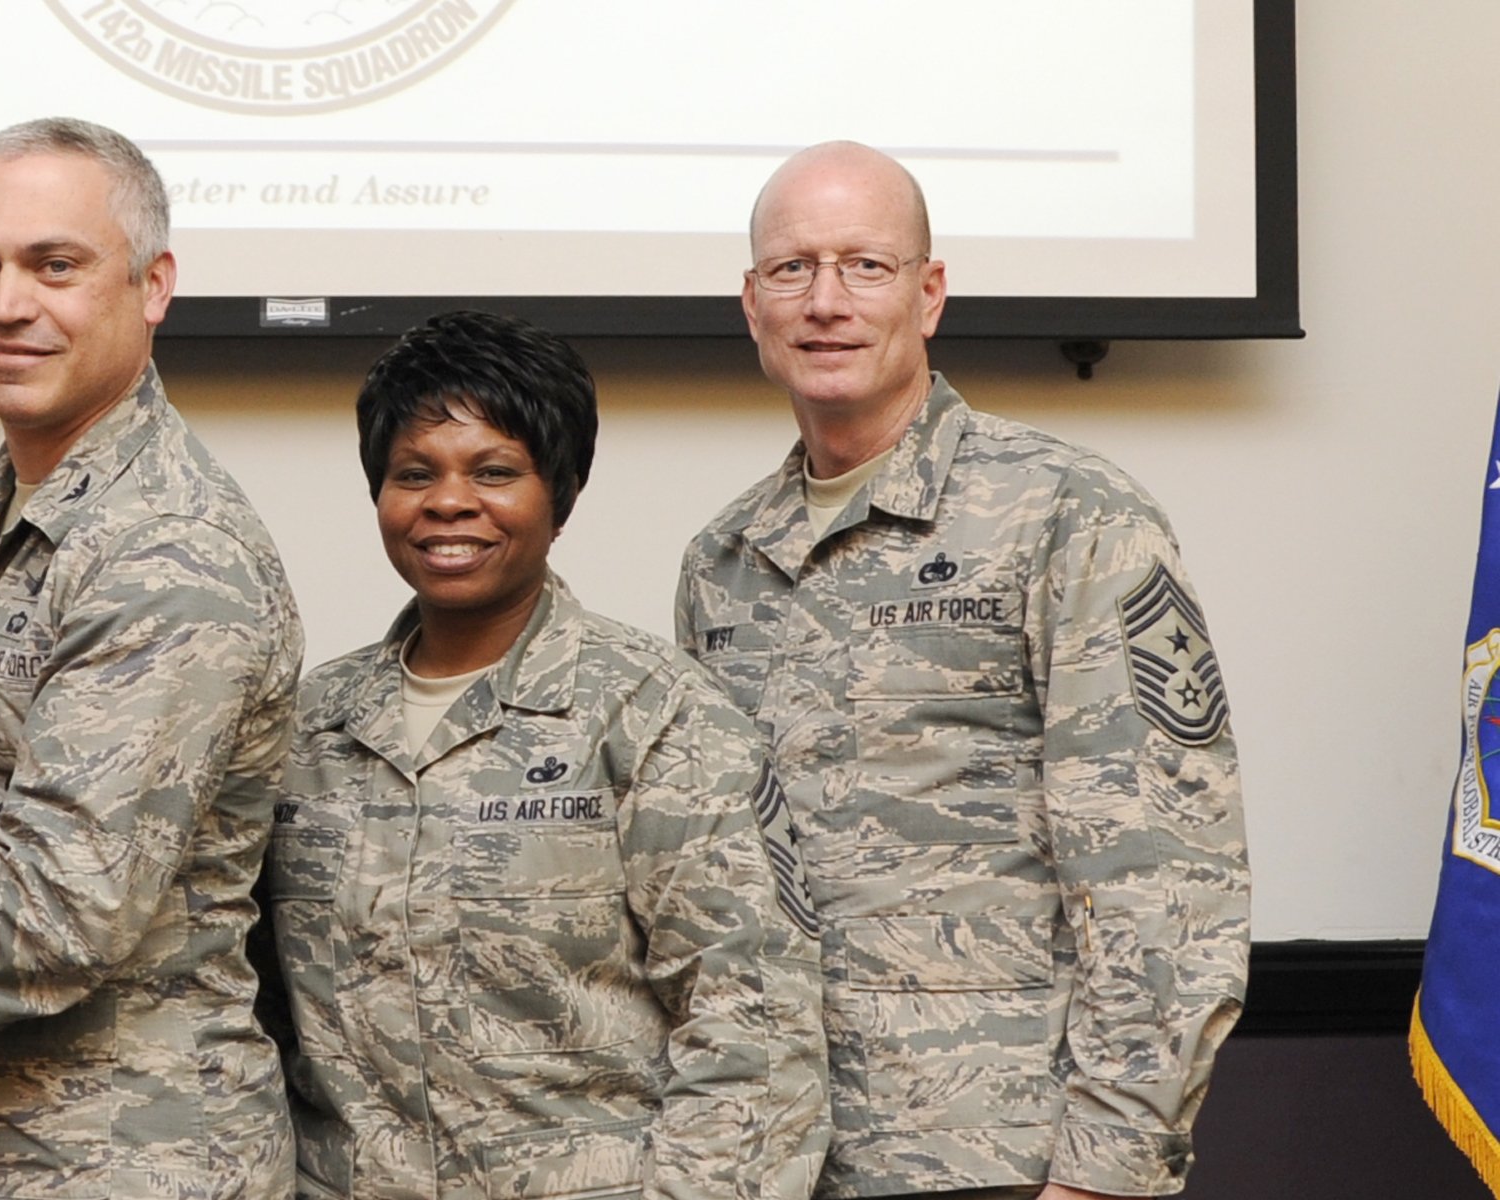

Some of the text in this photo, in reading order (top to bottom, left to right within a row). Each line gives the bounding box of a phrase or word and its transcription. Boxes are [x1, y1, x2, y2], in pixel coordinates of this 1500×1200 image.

[153, 38, 294, 100] MISSILE
[303, 0, 478, 99] SQUADRON
[166, 174, 490, 206] eter and Assure
[903, 601, 933, 623] AIR
[938, 597, 1004, 621] FORCE
[514, 799, 546, 820] AIR
[550, 795, 603, 820] FORCE
